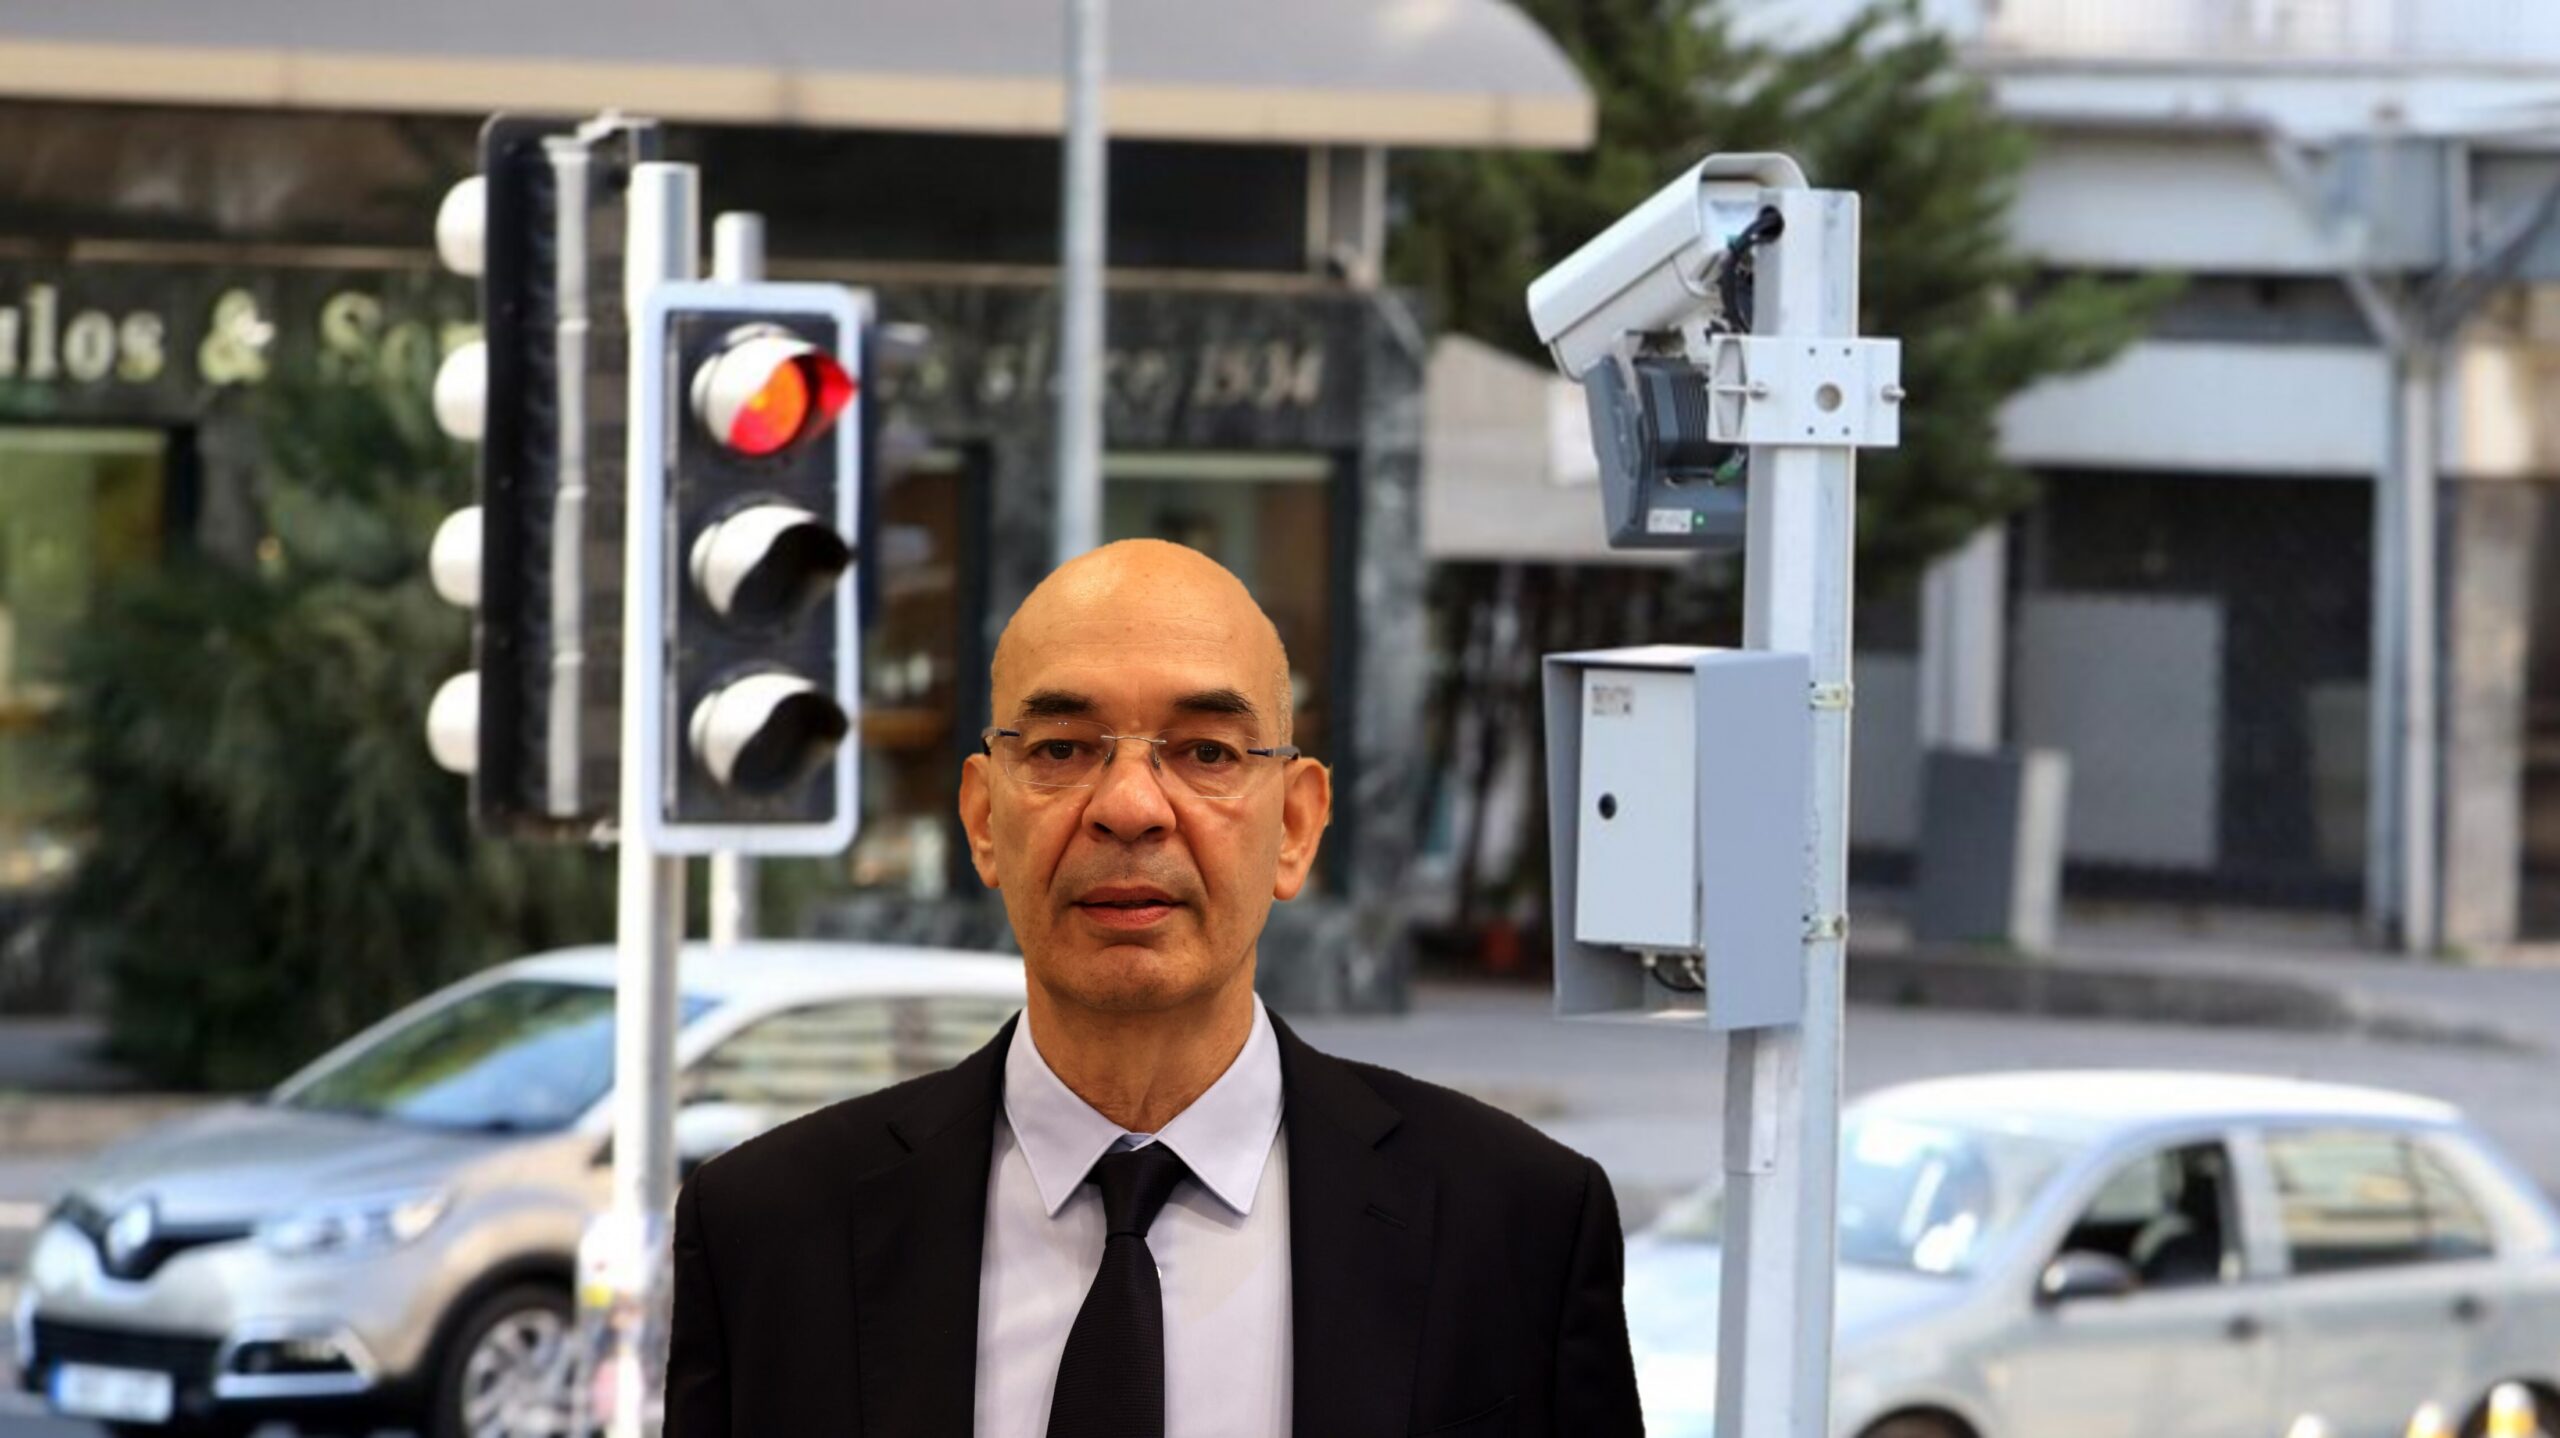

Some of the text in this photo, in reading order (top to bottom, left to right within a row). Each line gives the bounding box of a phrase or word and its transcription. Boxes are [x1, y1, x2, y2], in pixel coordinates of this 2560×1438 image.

[199, 288, 275, 384] &
[319, 291, 487, 386] So
[979, 334, 1172, 403] sice
